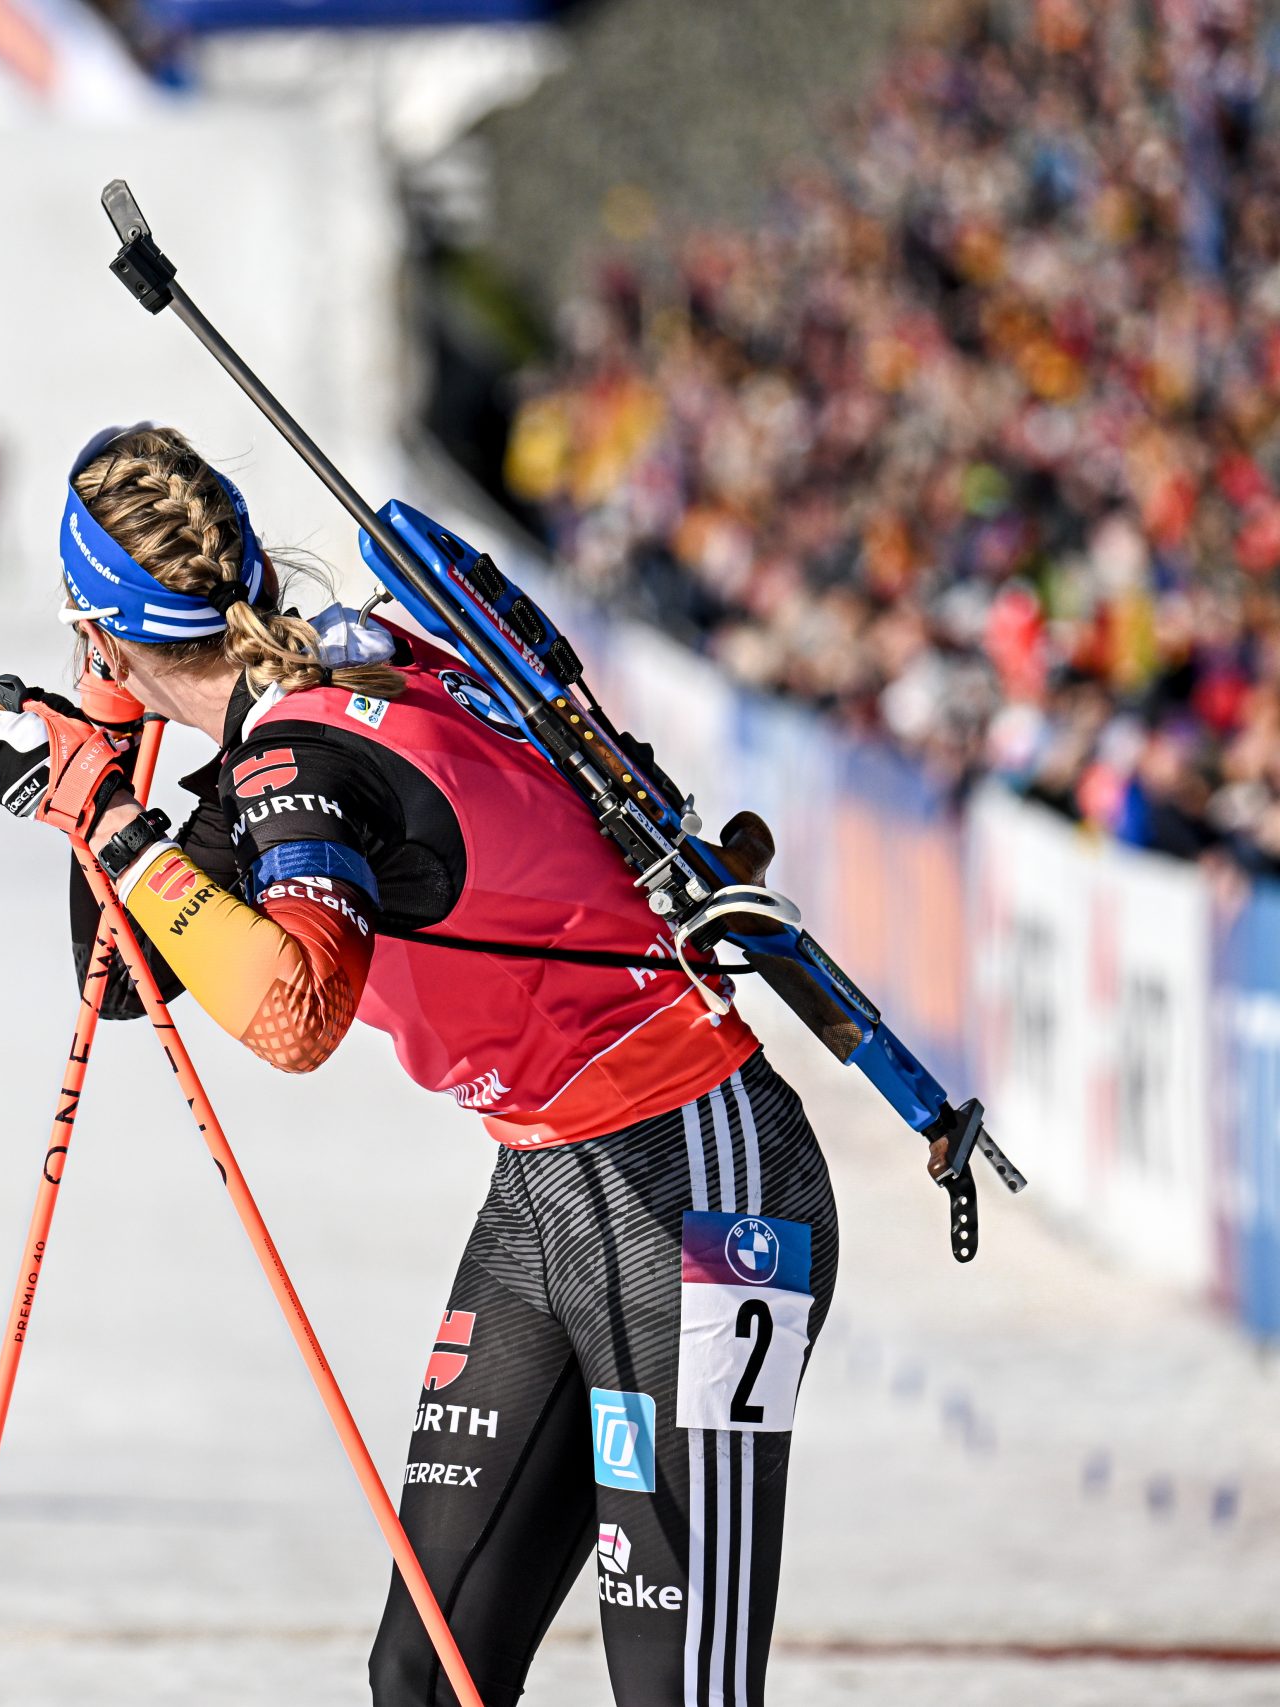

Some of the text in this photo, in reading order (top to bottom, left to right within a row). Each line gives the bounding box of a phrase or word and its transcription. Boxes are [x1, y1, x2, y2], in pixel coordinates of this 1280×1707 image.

[231, 793, 343, 847] WÜRTH
[170, 883, 222, 936] WÜRT
[256, 884, 369, 937] tectake
[734, 1221, 773, 1241] BMW
[14, 1241, 45, 1342] PREMIO 40
[730, 1299, 773, 1424] 2
[594, 1403, 639, 1479] TQ
[598, 1573, 683, 1610] ctake
